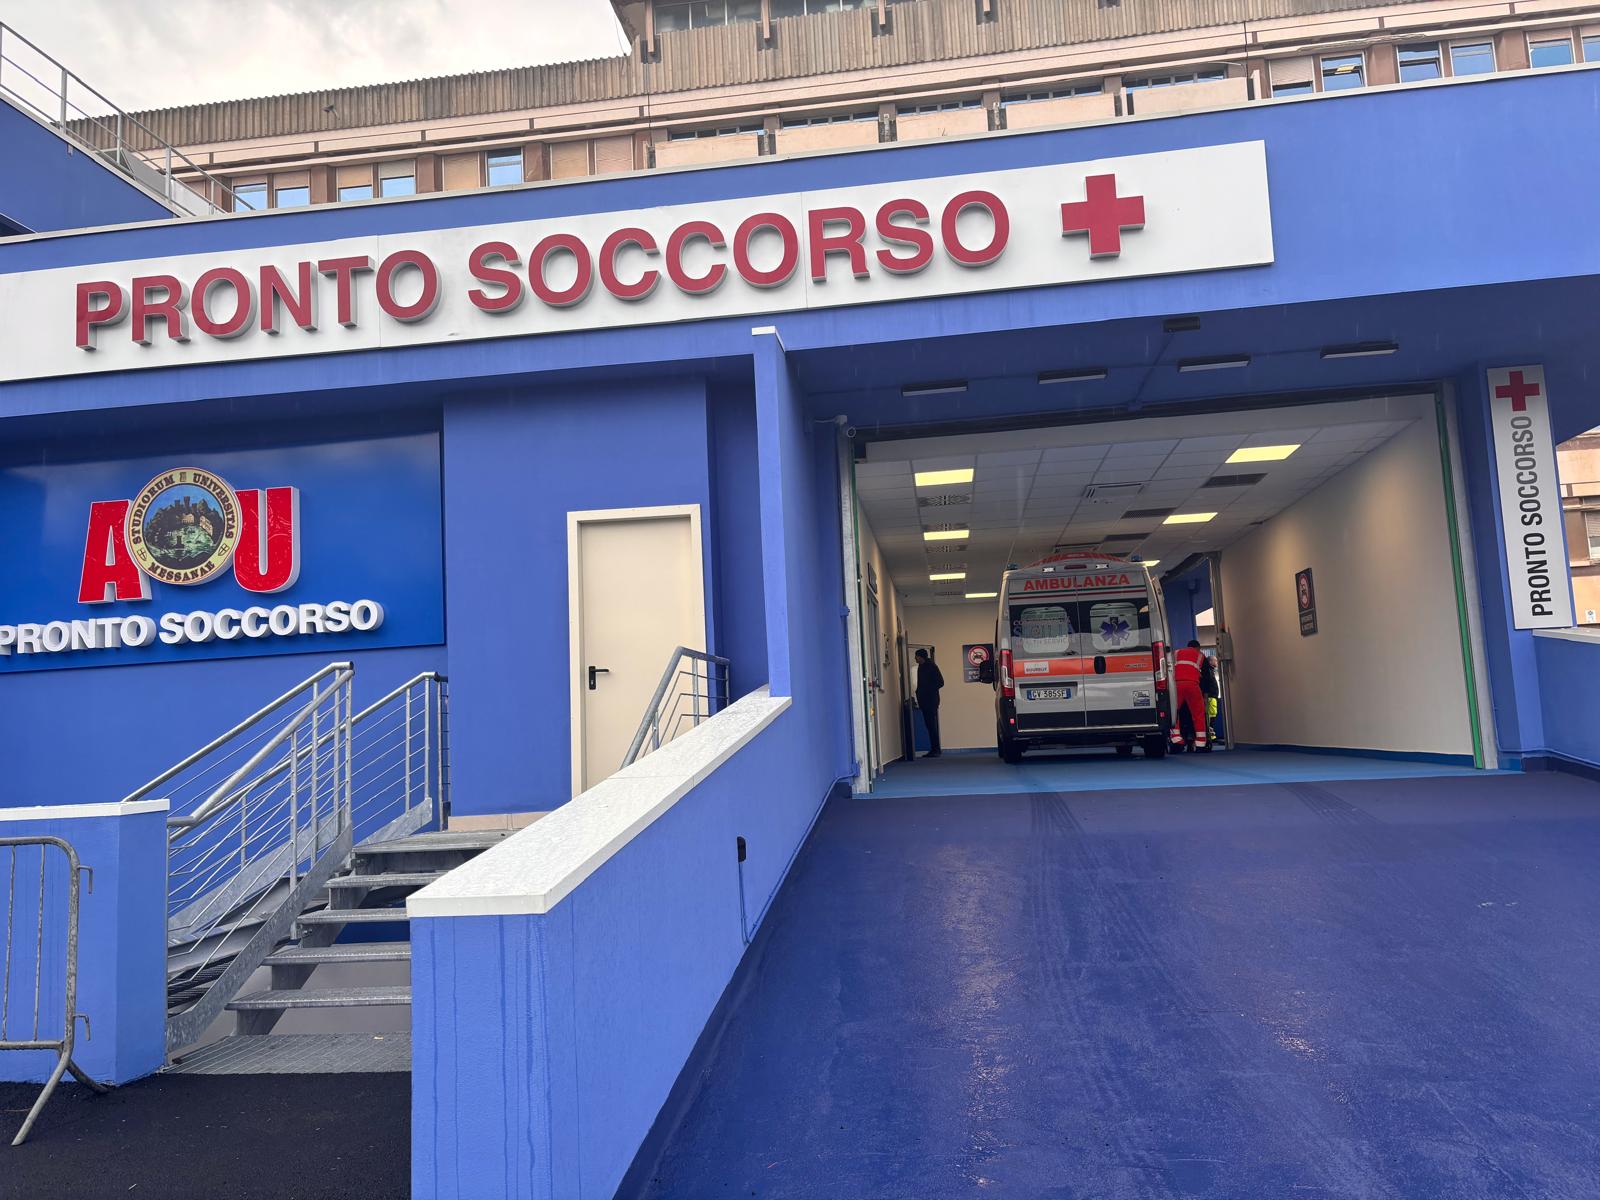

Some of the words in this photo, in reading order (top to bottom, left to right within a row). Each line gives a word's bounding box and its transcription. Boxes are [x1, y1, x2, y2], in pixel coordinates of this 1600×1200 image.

[76, 249, 440, 350] PRONTO
[467, 189, 1011, 313] SOCCORSO
[1510, 415, 1543, 526] SOCCORSO
[131, 474, 176, 545] STUDIORUM
[192, 472, 236, 540] UNIVERSITAS
[148, 560, 215, 582] MESSANAE
[1023, 574, 1130, 591] AMBULANZA
[1523, 532, 1554, 617] PRONTO
[0, 615, 156, 656] PRONTO
[158, 599, 384, 645] SOCCORSO
